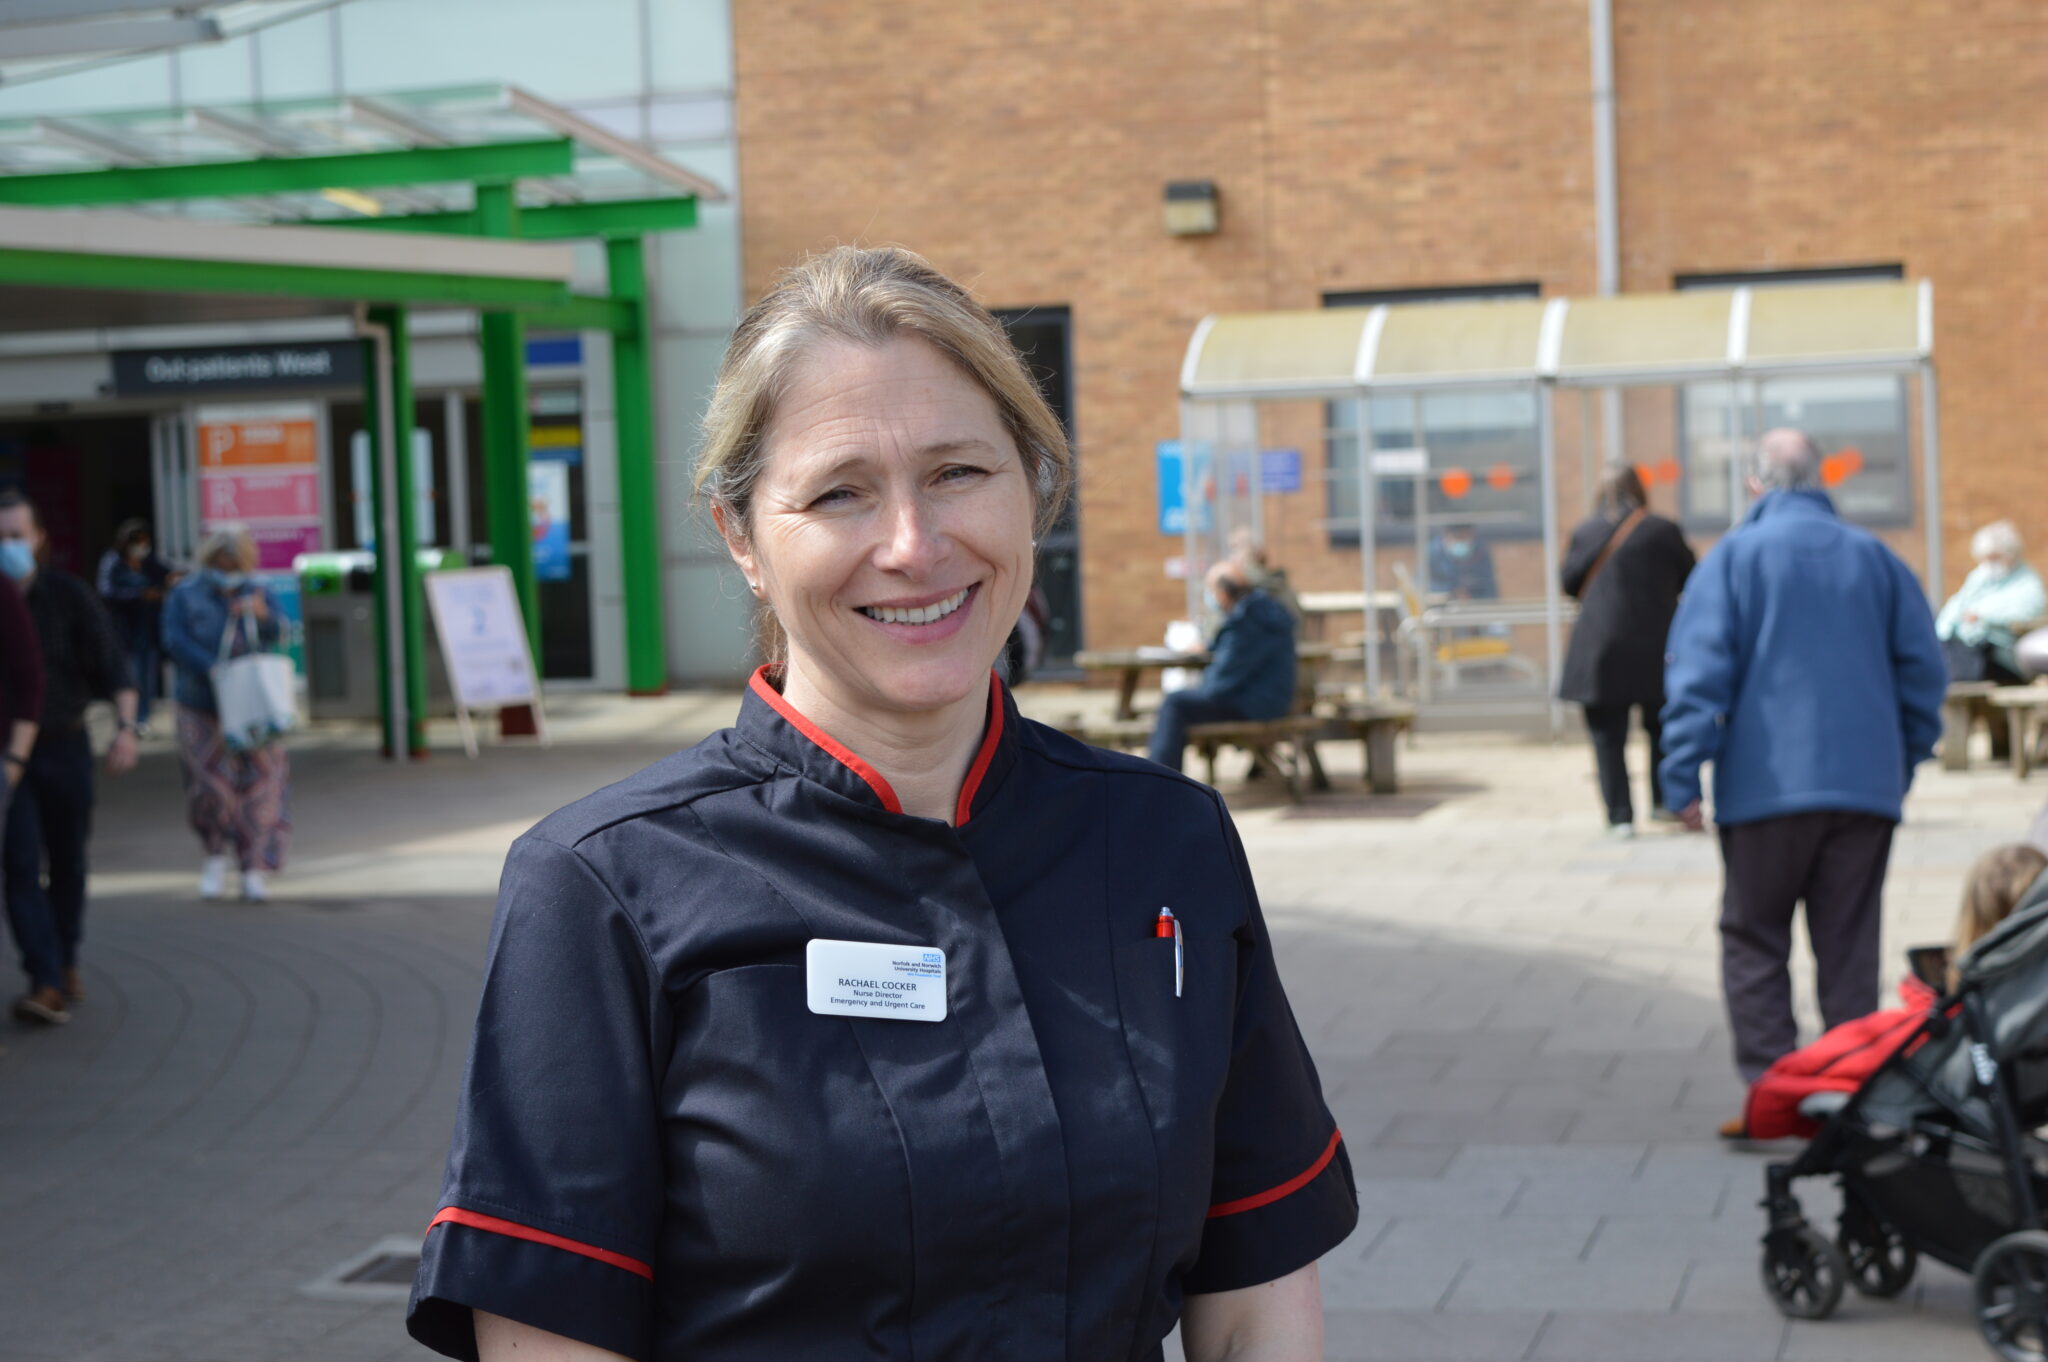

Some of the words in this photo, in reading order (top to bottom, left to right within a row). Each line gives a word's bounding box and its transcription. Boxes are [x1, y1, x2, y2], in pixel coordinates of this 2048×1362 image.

[275, 352, 331, 375] West
[923, 954, 941, 962] NHS
[838, 978, 880, 989] RACHAEL
[881, 981, 917, 991] COCKER
[853, 989, 873, 998] Nurse
[875, 991, 903, 999] Director
[830, 997, 868, 1007] Emergency
[884, 1001, 908, 1009] Urgent
[910, 1002, 925, 1010] Care
